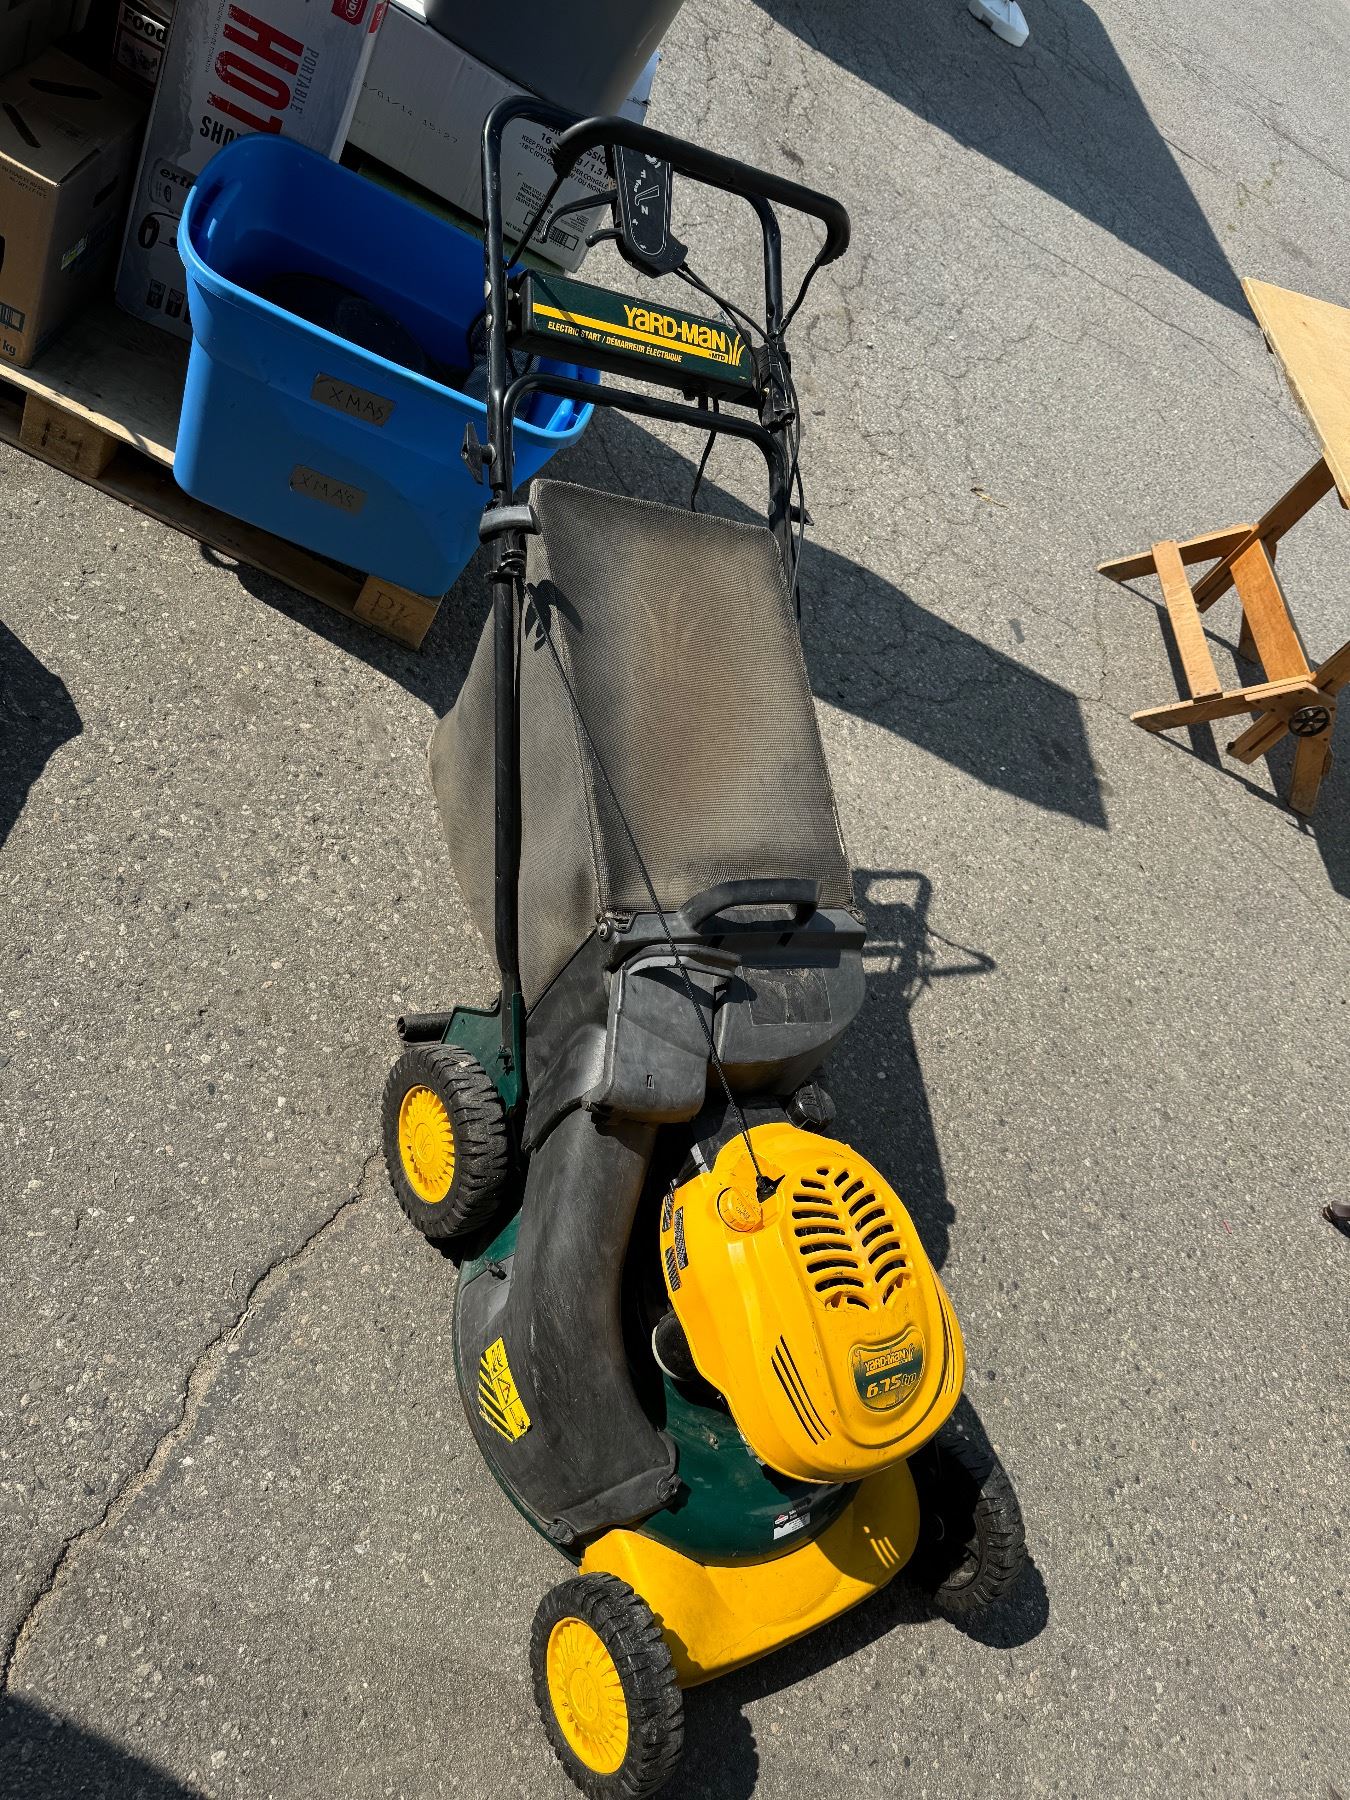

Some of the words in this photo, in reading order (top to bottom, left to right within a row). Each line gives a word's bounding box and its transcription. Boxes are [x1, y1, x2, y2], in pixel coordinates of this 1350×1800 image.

[122, 10, 168, 45] Food
[290, 47, 320, 114] PORTABLE
[199, 115, 241, 146] SHO
[541, 132, 553, 145] 16
[590, 163, 604, 176] 1.5
[547, 321, 580, 337] ELECTRIC
[580, 329, 602, 343] START
[601, 335, 606, 344] /
[605, 334, 646, 354] DÉMARREUR
[645, 344, 683, 363] ÉLECTRIQUE
[328, 385, 385, 421] XMAS
[301, 473, 355, 508] XMAS
